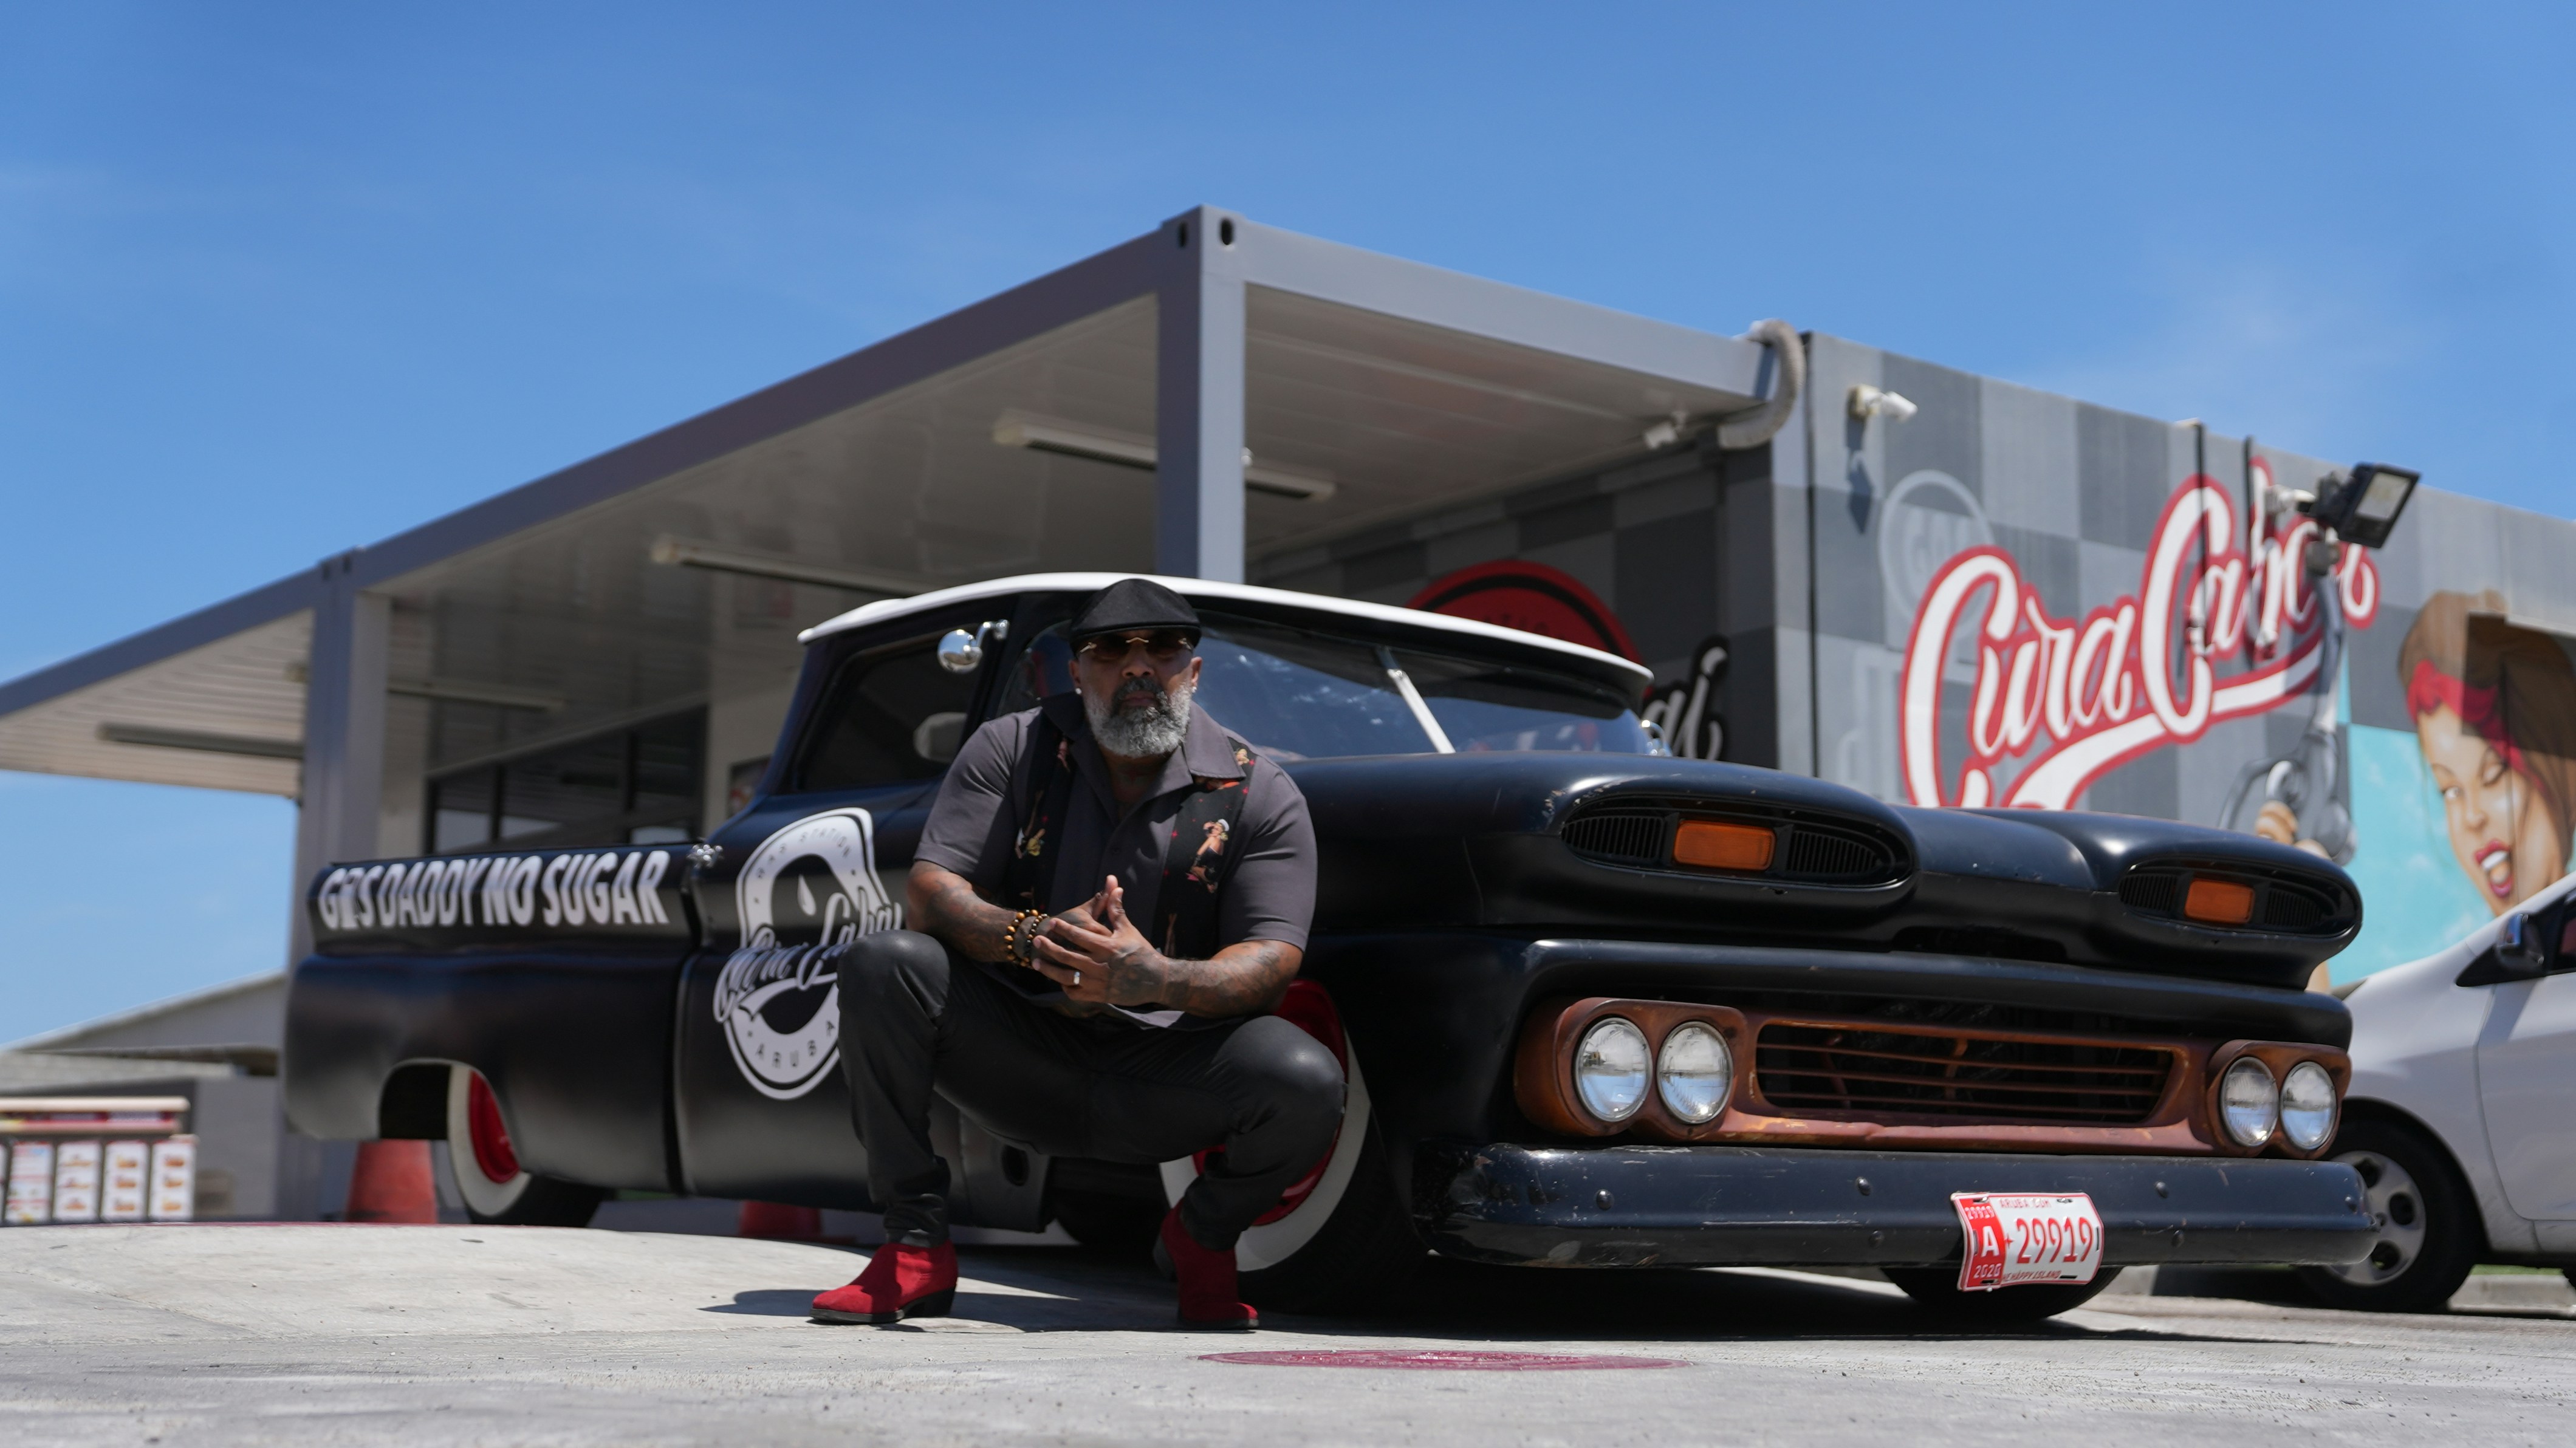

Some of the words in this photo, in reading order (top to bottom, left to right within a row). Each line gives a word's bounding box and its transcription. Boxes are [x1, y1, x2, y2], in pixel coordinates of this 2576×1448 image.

[376, 857, 492, 927] DADDY
[481, 855, 543, 927] NO
[541, 850, 671, 927] SUGAR
[756, 1020, 836, 1069] ARUBA
[1981, 1226, 1999, 1257] A
[2015, 1217, 2094, 1264] 29919
[1973, 1263, 2002, 1278] 2020
[2012, 1271, 2035, 1280] HAPPY
[2033, 1270, 2062, 1279] ISLAND
